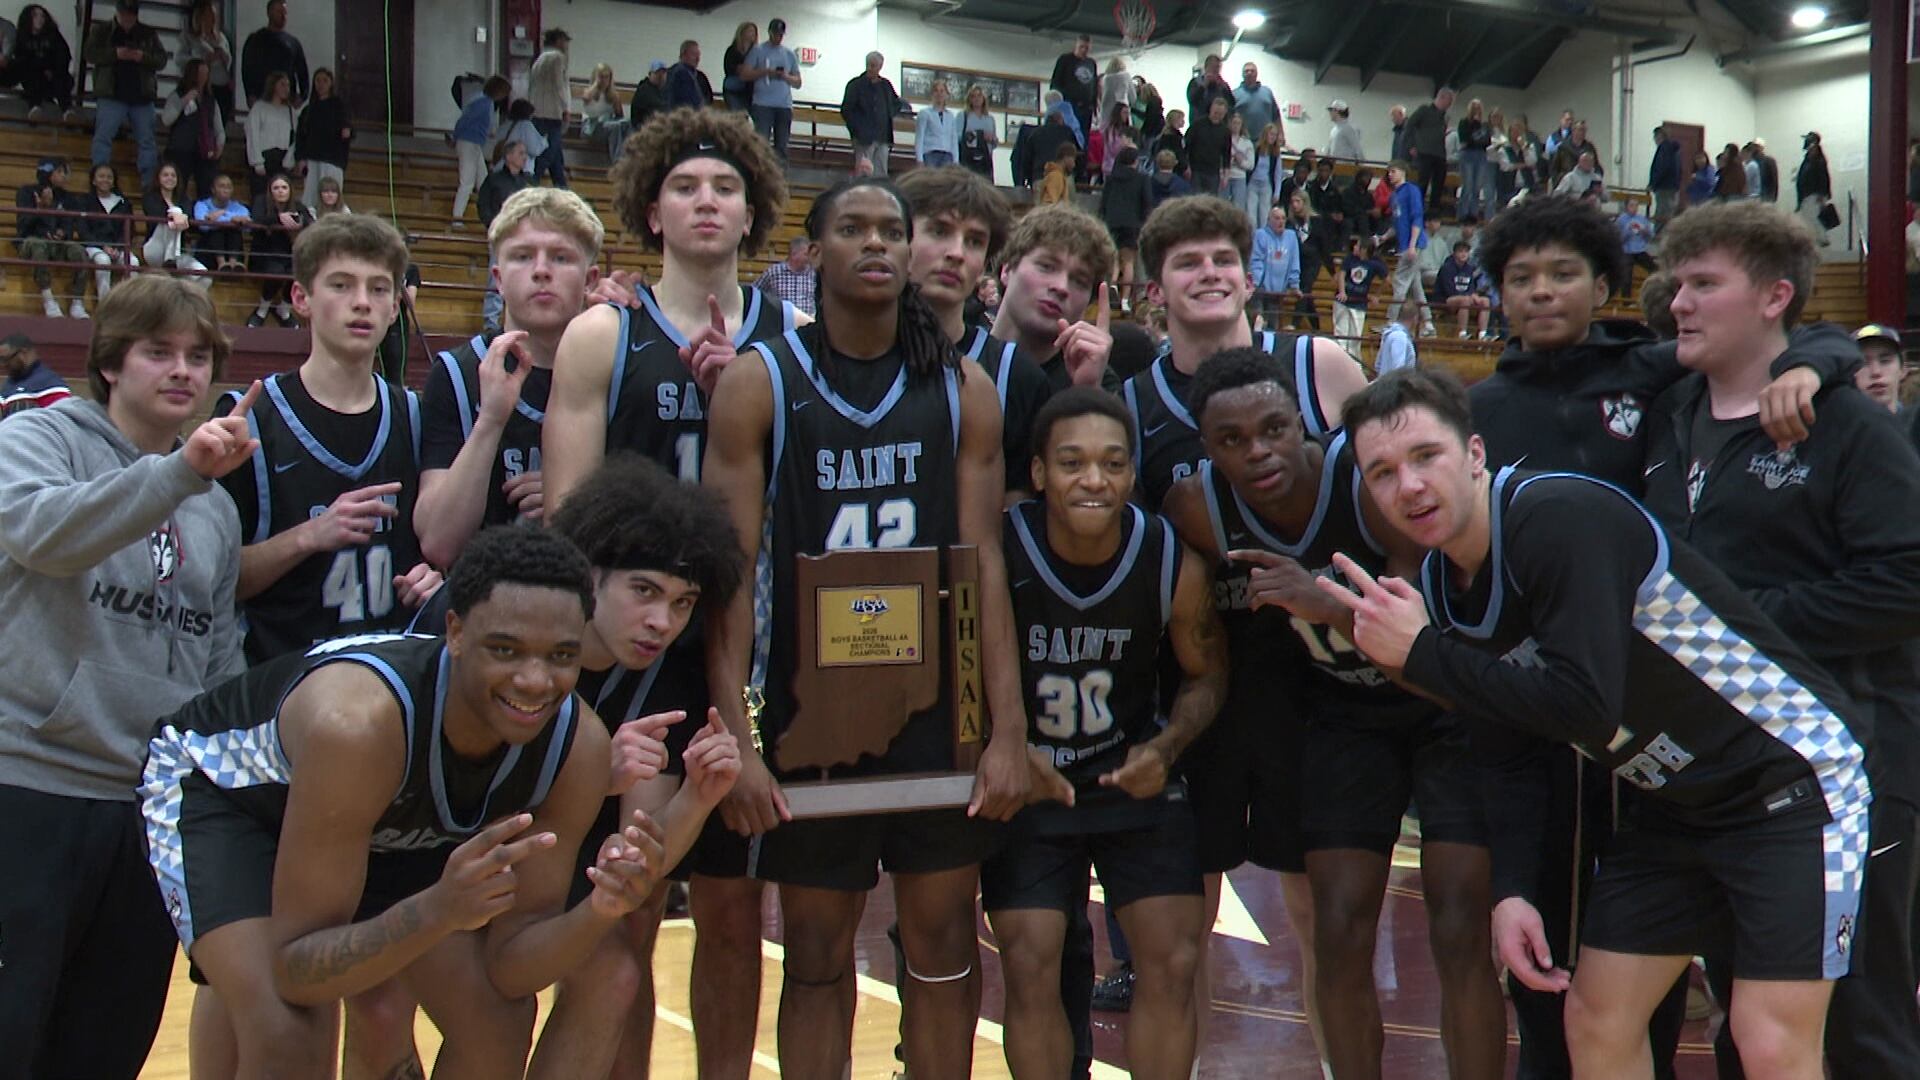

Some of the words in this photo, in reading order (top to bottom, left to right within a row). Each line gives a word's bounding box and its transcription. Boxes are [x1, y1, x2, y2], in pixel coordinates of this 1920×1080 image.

[816, 441, 922, 491] SAINT
[825, 498, 917, 550] 42
[322, 545, 393, 622] 40
[831, 635, 850, 644] BOYS
[853, 634, 897, 642] BASKETBALL
[900, 633, 909, 641] 4A
[849, 648, 891, 657] CHAMPIONS
[850, 642, 889, 650] SECTIONAL
[957, 588, 977, 737] IHSAA
[1027, 624, 1132, 665] SAINT
[1035, 669, 1115, 739] 30
